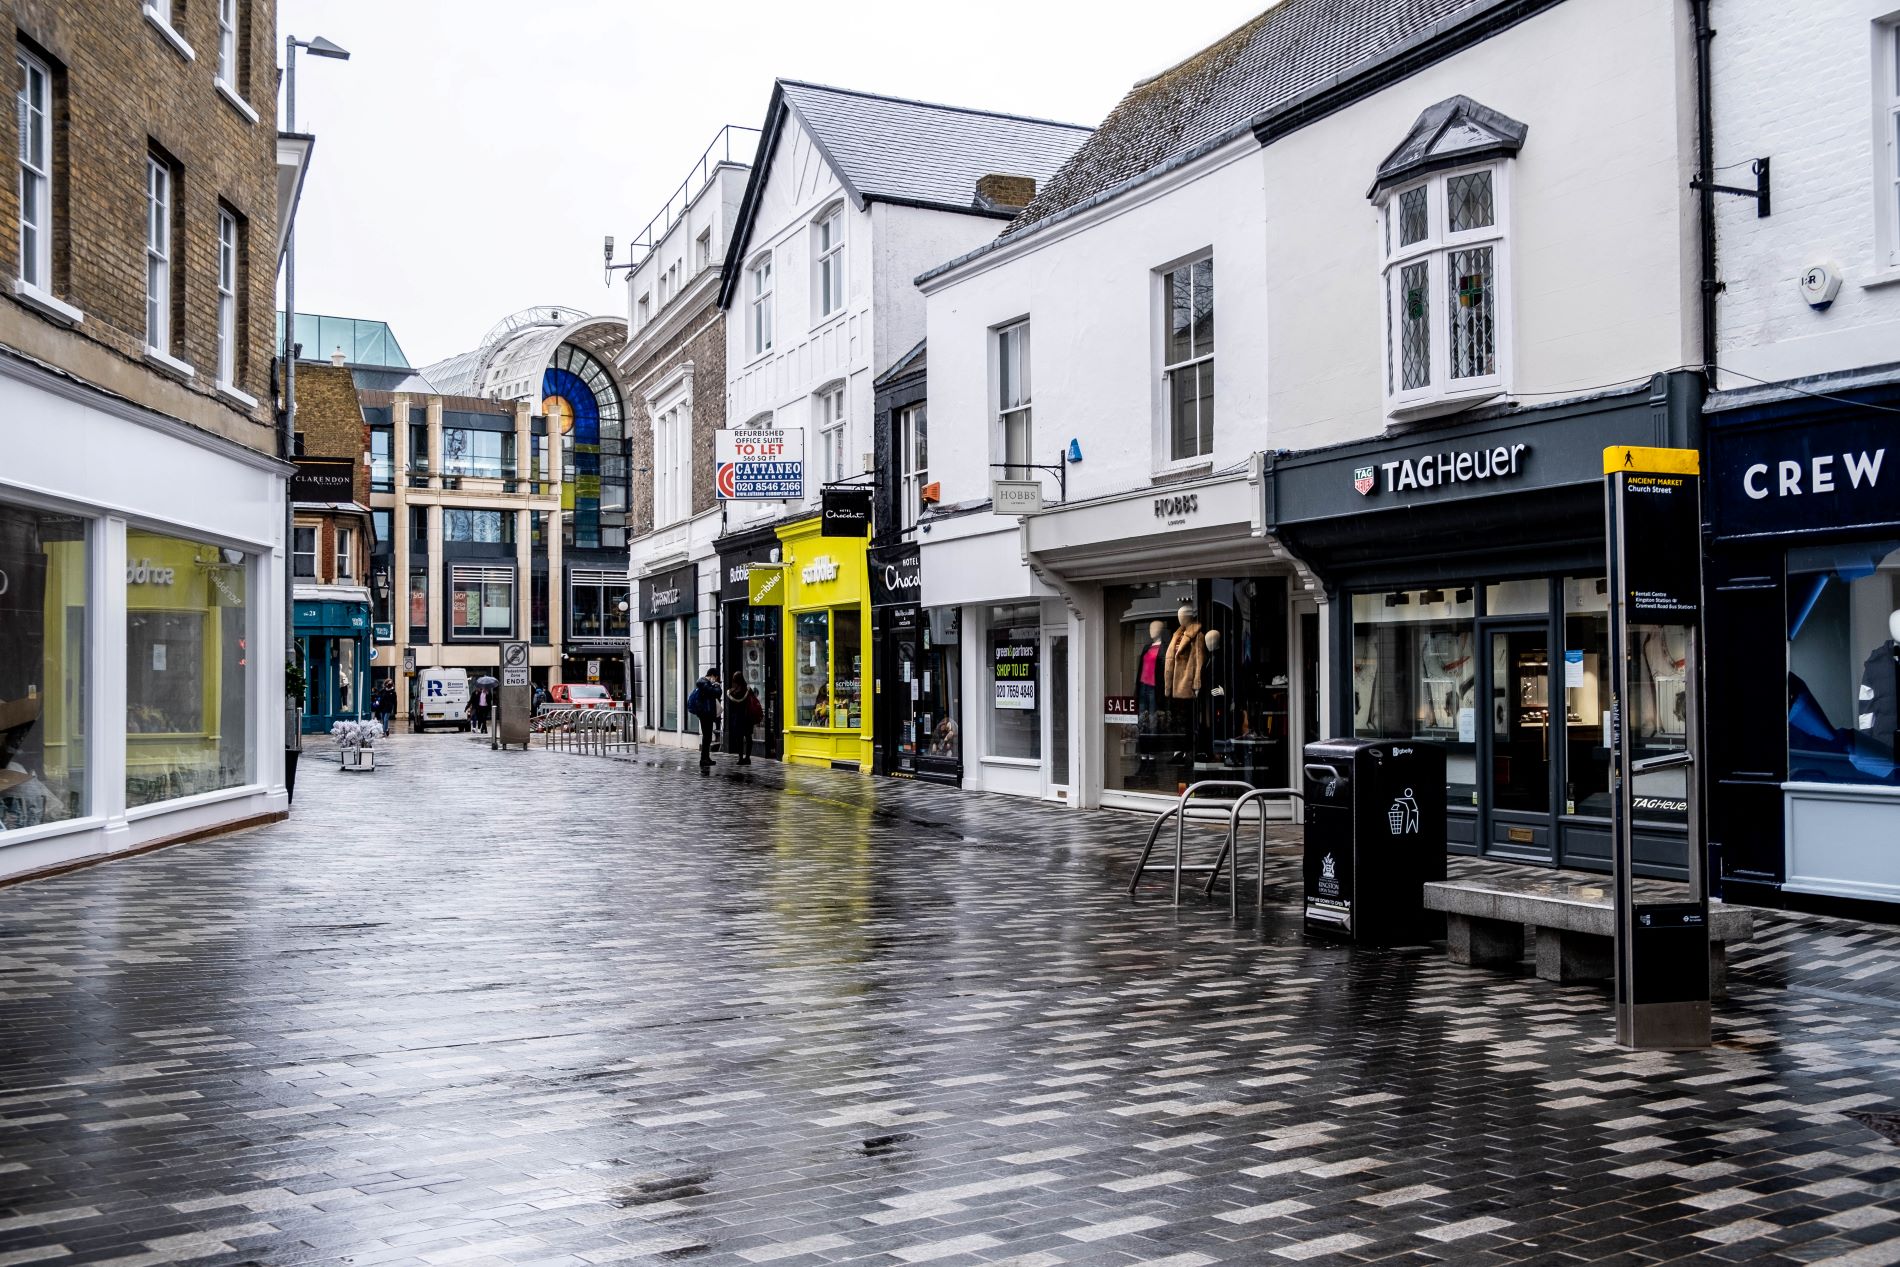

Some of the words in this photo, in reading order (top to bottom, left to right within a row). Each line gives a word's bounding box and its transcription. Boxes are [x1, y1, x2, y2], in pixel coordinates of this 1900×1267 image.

[735, 444, 755, 455] TO
[760, 444, 784, 455] LET
[735, 463, 801, 475] CATTANEO
[1355, 468, 1372, 480] TAG
[1743, 448, 1886, 500] CREW
[295, 475, 350, 485] CLARENDON
[1627, 477, 1656, 485] ANCIENT
[1657, 478, 1683, 486] MARKET
[736, 482, 754, 491] 020
[755, 482, 779, 491] 8546
[780, 482, 801, 491] 2166
[1627, 484, 1651, 493] Church
[1652, 485, 1672, 494] Street
[1000, 490, 1036, 500] HOBBS
[1154, 493, 1198, 518] HOBBS
[902, 557, 919, 567] HOTEL
[753, 572, 782, 604] scribbler
[996, 662, 1011, 677] SHOP
[1011, 662, 1019, 677] TO
[1019, 662, 1030, 677] LET
[835, 679, 861, 687] scribbler
[996, 684, 1006, 698] 020
[1006, 684, 1020, 698] 7659
[1108, 699, 1135, 712] SALE
